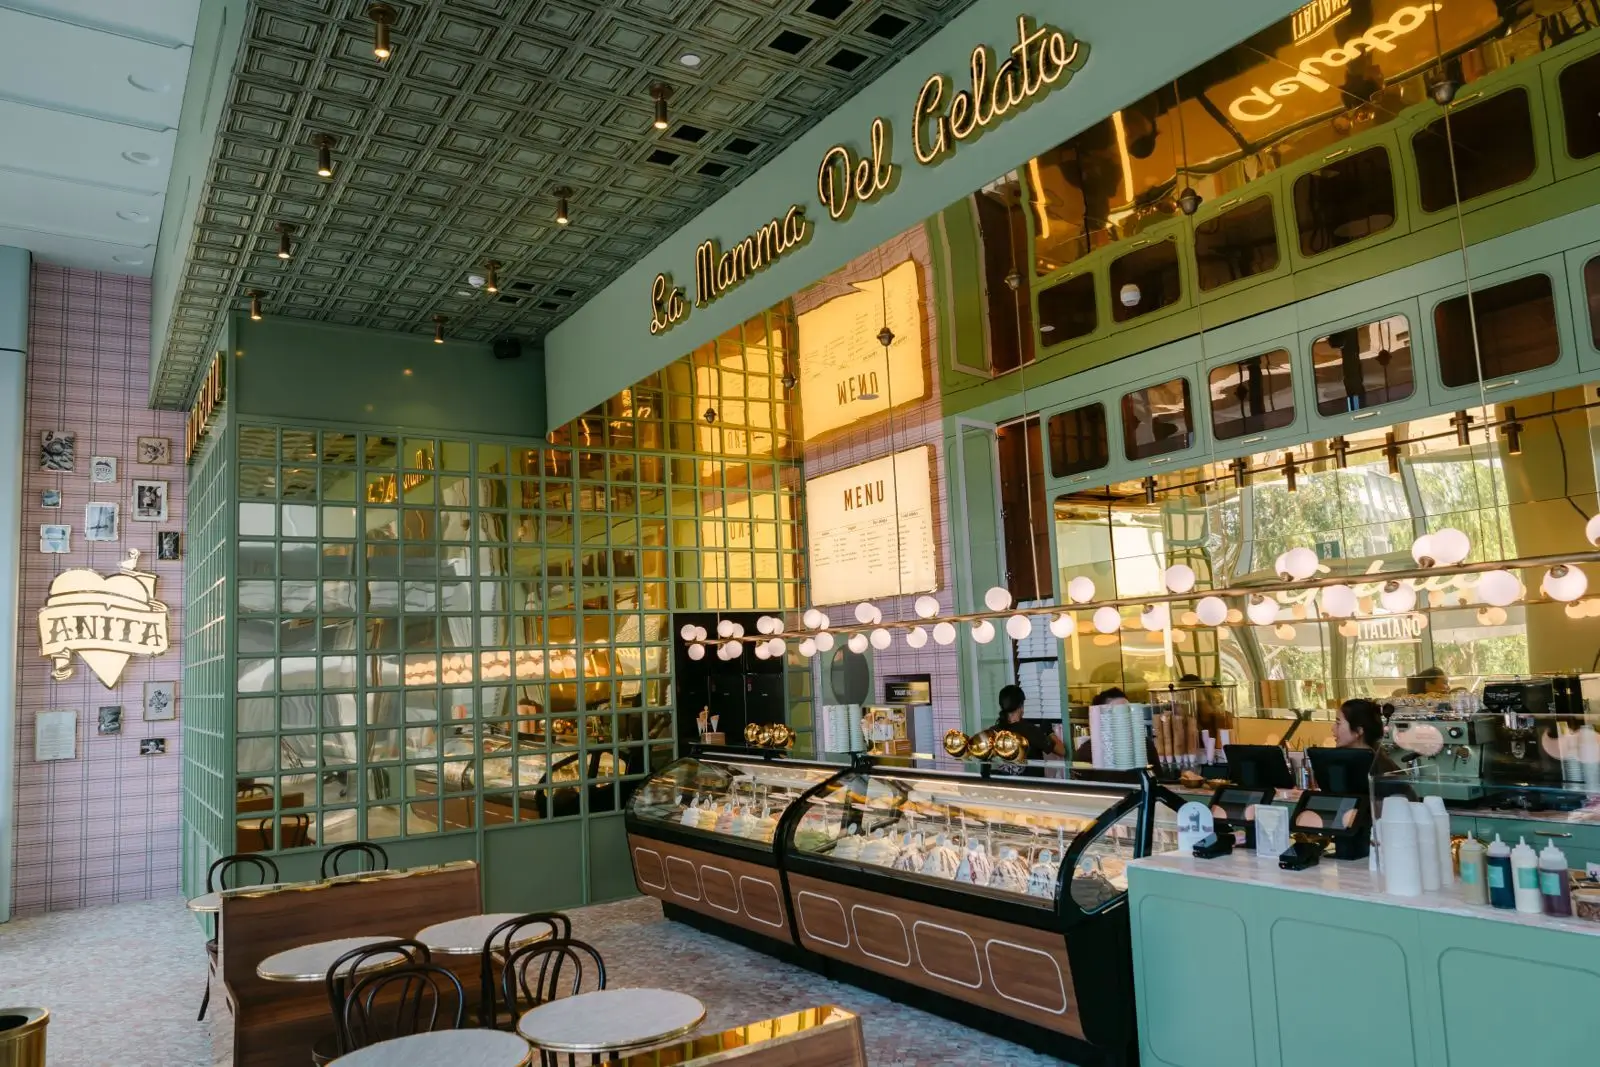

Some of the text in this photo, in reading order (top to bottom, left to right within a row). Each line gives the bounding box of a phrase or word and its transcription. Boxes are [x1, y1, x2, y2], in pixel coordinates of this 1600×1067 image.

[649, 273, 685, 335] La
[695, 205, 809, 308] Mamma
[818, 118, 893, 221] Del
[912, 15, 1078, 165] Gelato
[844, 480, 884, 511] MENU
[46, 615, 163, 647] ANITA
[1358, 617, 1421, 639] ITALIANO
